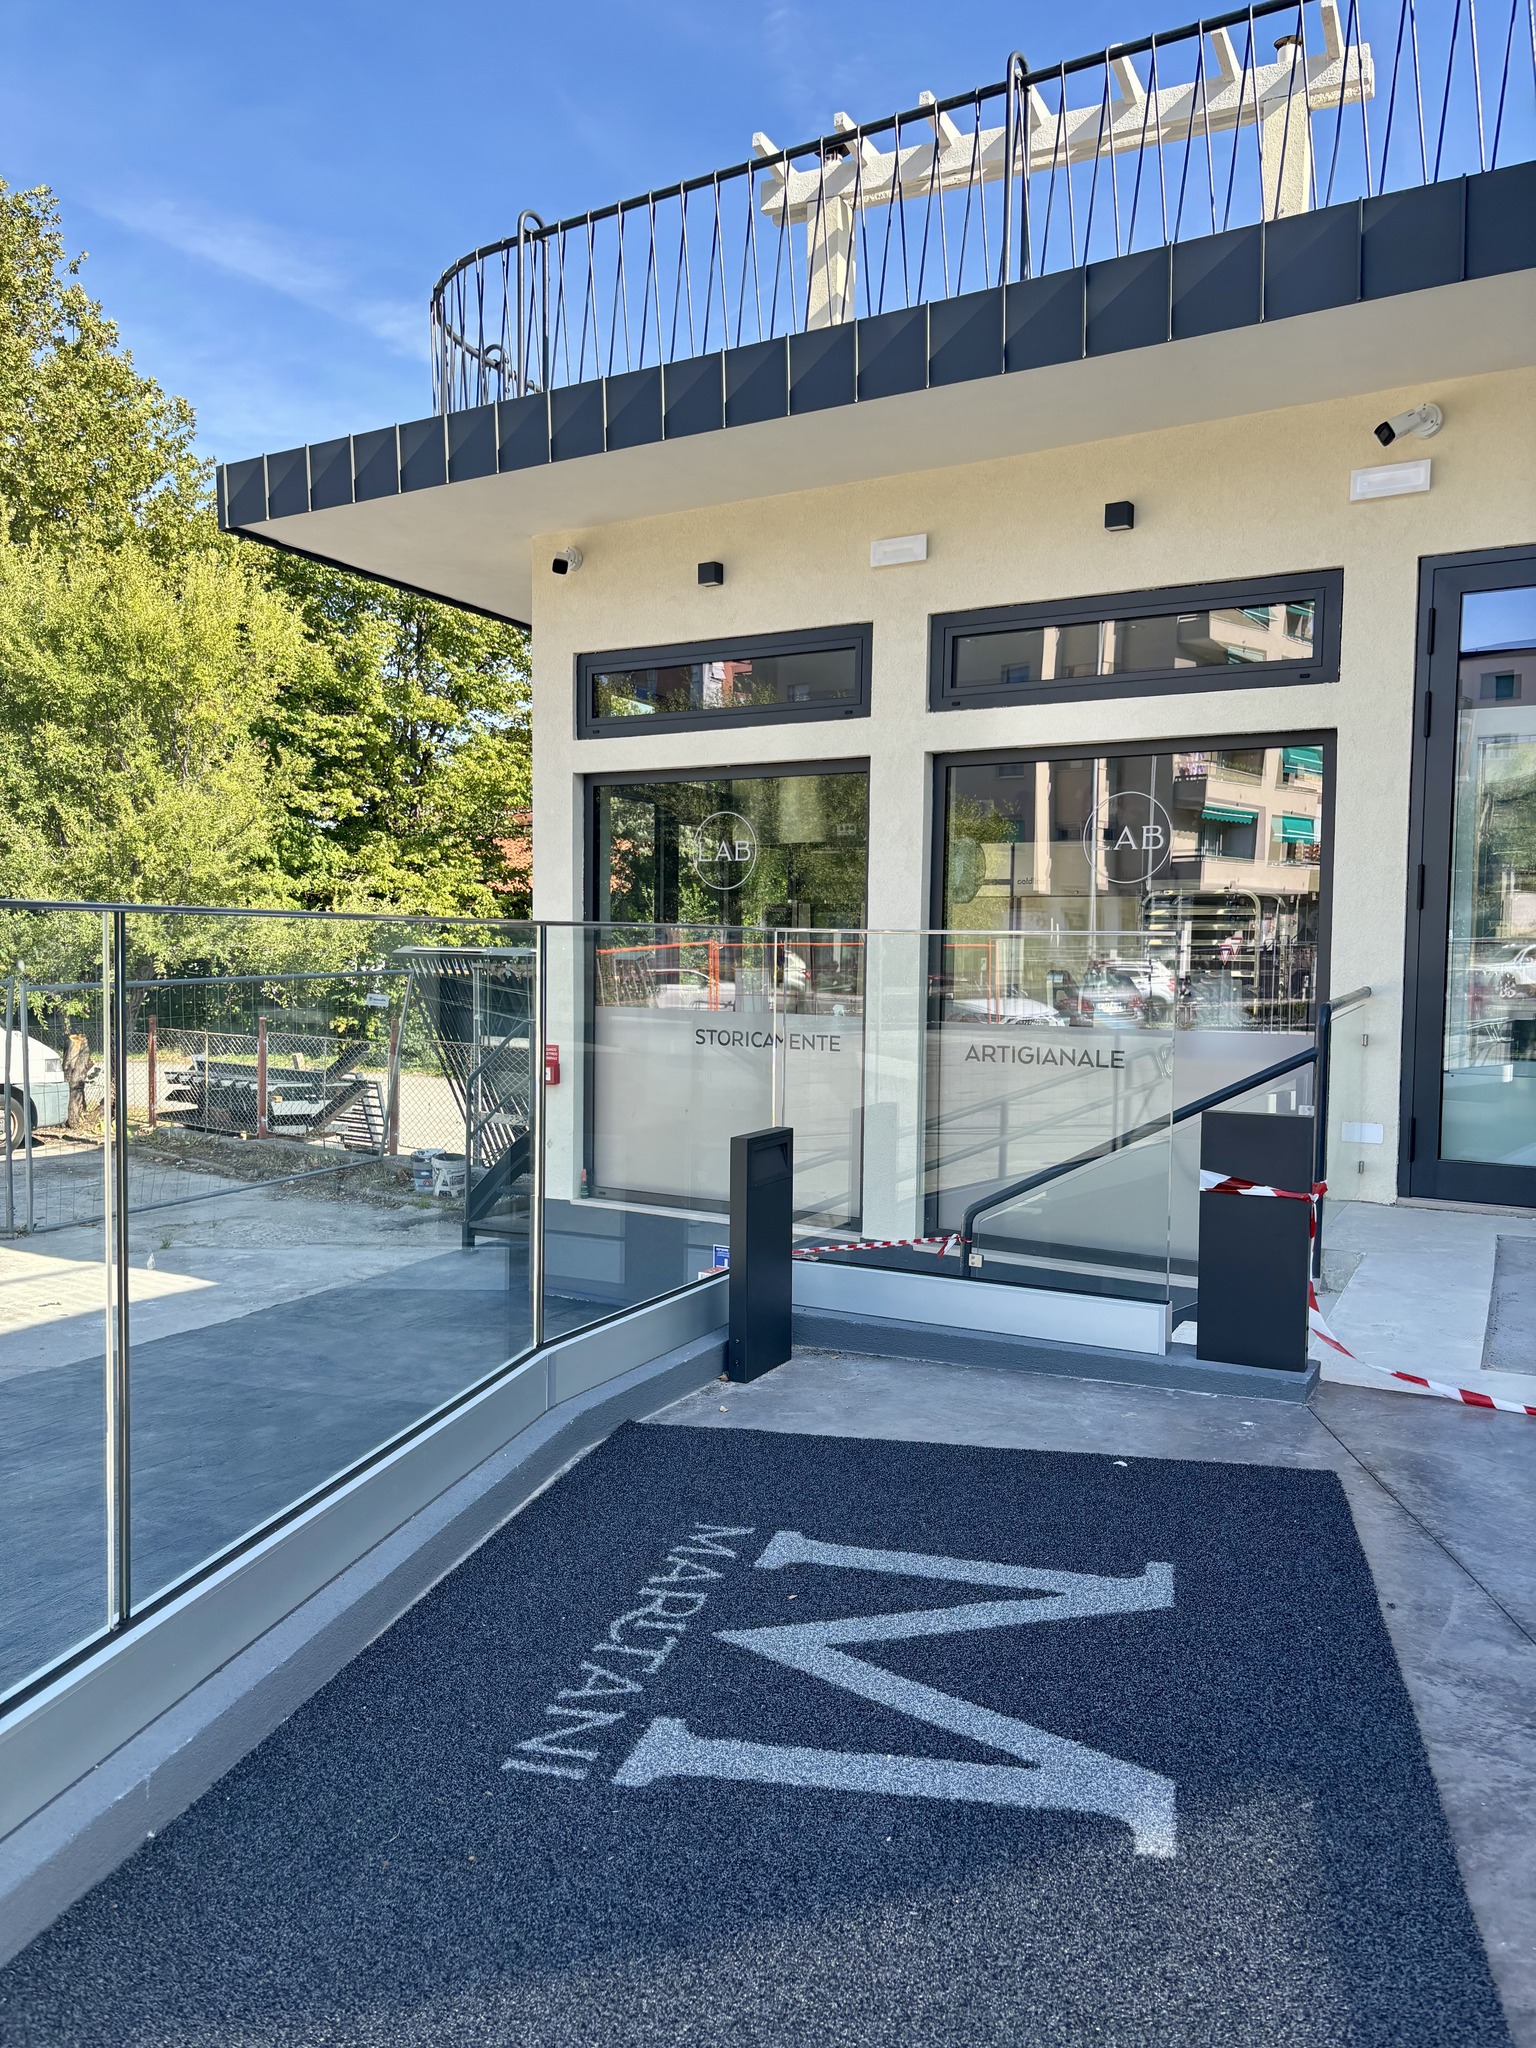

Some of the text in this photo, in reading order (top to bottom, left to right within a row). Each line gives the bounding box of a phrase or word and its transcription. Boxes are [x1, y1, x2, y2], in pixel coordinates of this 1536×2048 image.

[1091, 825, 1164, 850] LAB
[698, 840, 751, 861] LAB
[964, 1044, 1125, 1069] ARTIGIANALE
[500, 1522, 755, 1780] MARITANI
